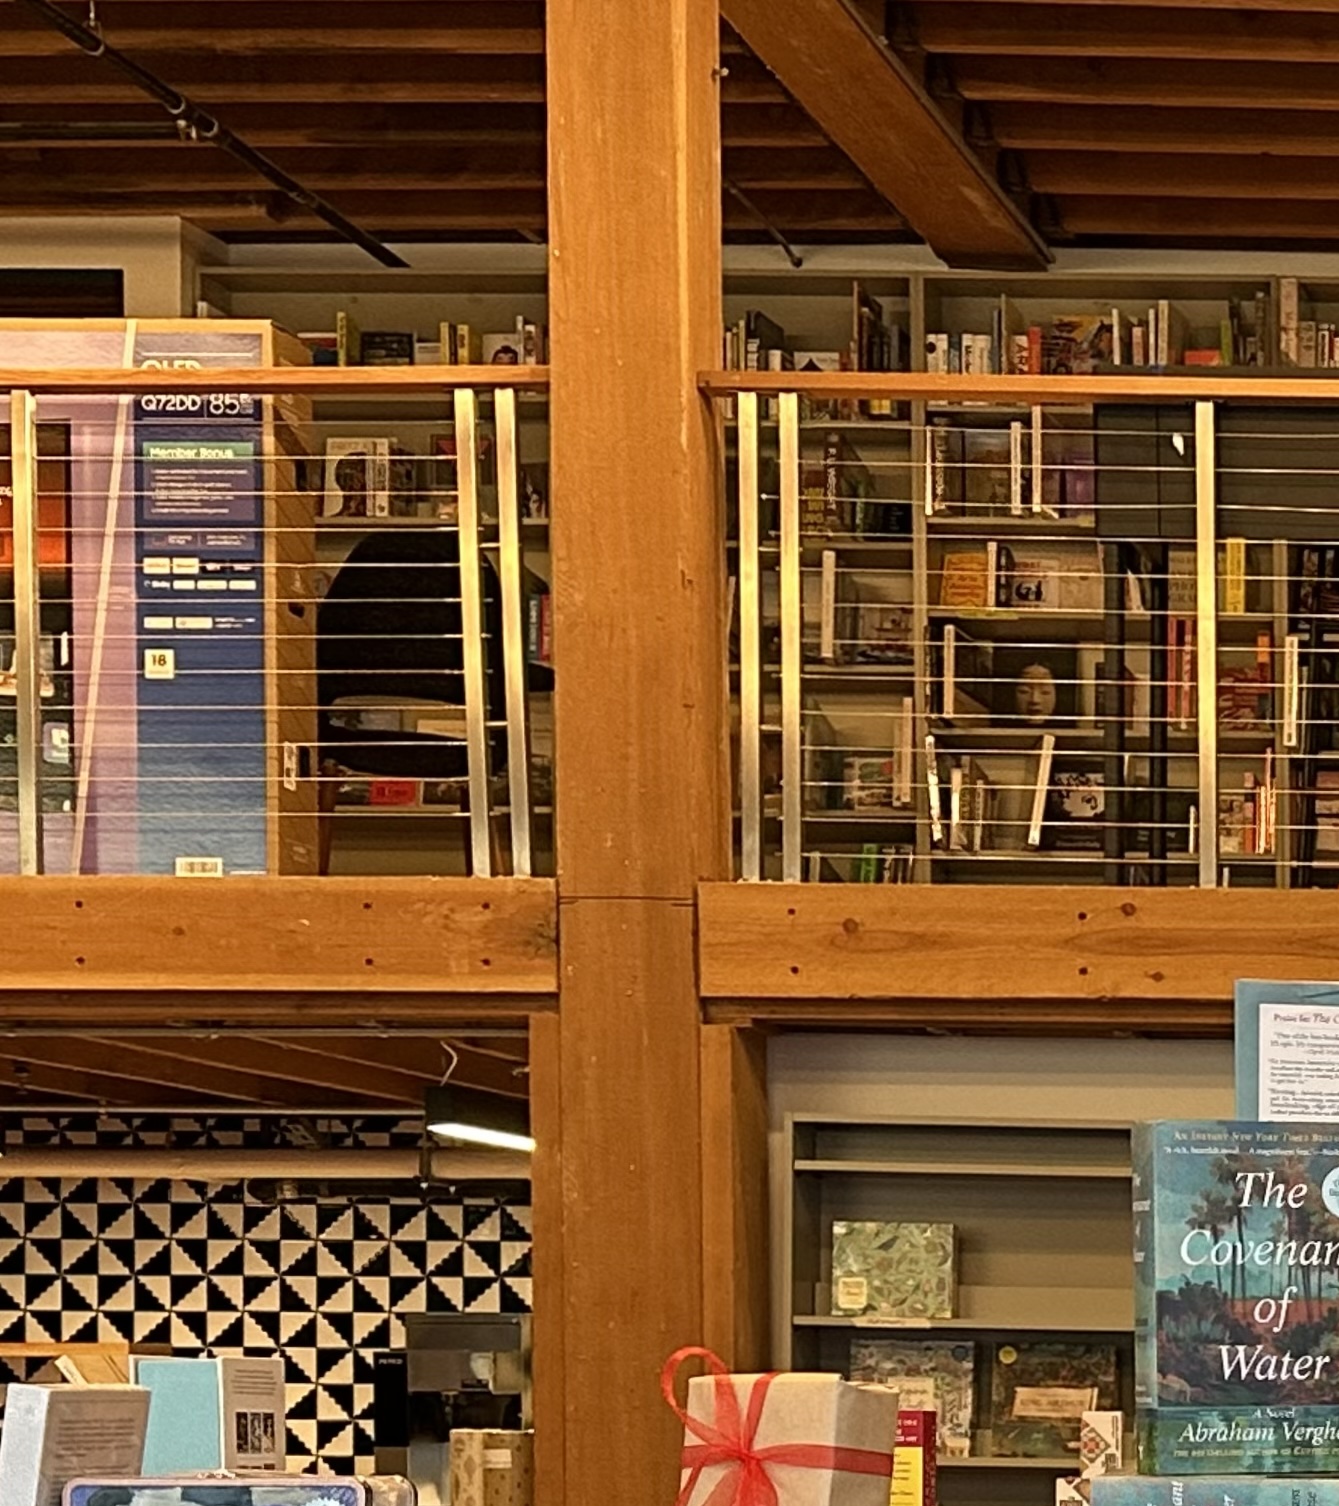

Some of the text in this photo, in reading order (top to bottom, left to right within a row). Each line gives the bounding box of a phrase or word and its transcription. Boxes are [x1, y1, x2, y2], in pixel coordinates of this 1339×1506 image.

[141, 394, 239, 414] Q72DD 85
[1237, 1171, 1308, 1208] The
[1253, 1287, 1296, 1332] of
[1219, 1344, 1329, 1382] Water
[1179, 1421, 1273, 1444] Abraham
